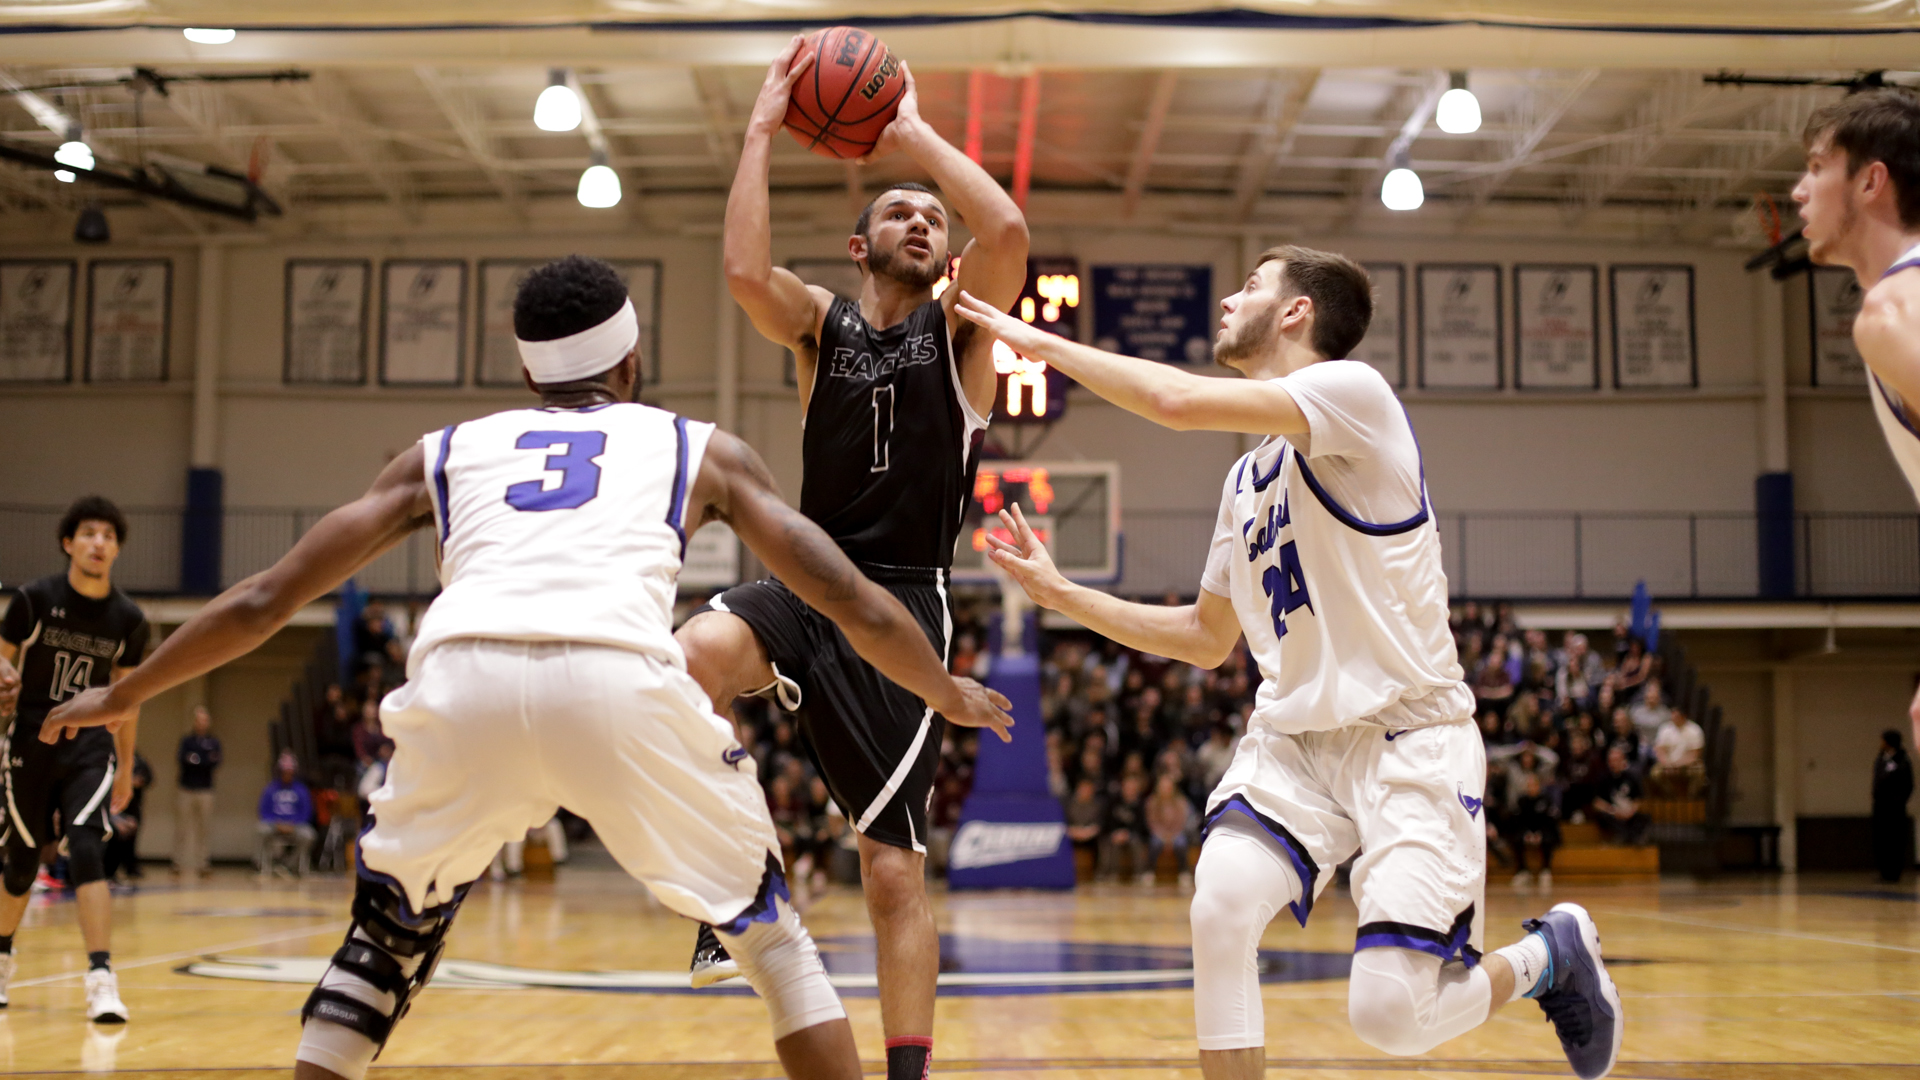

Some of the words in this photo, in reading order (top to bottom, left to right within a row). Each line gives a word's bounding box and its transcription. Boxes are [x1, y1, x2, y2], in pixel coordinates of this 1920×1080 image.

[504, 430, 608, 512] 3
[870, 383, 895, 473] 1
[1261, 539, 1315, 644] 24
[49, 650, 94, 702] 14
